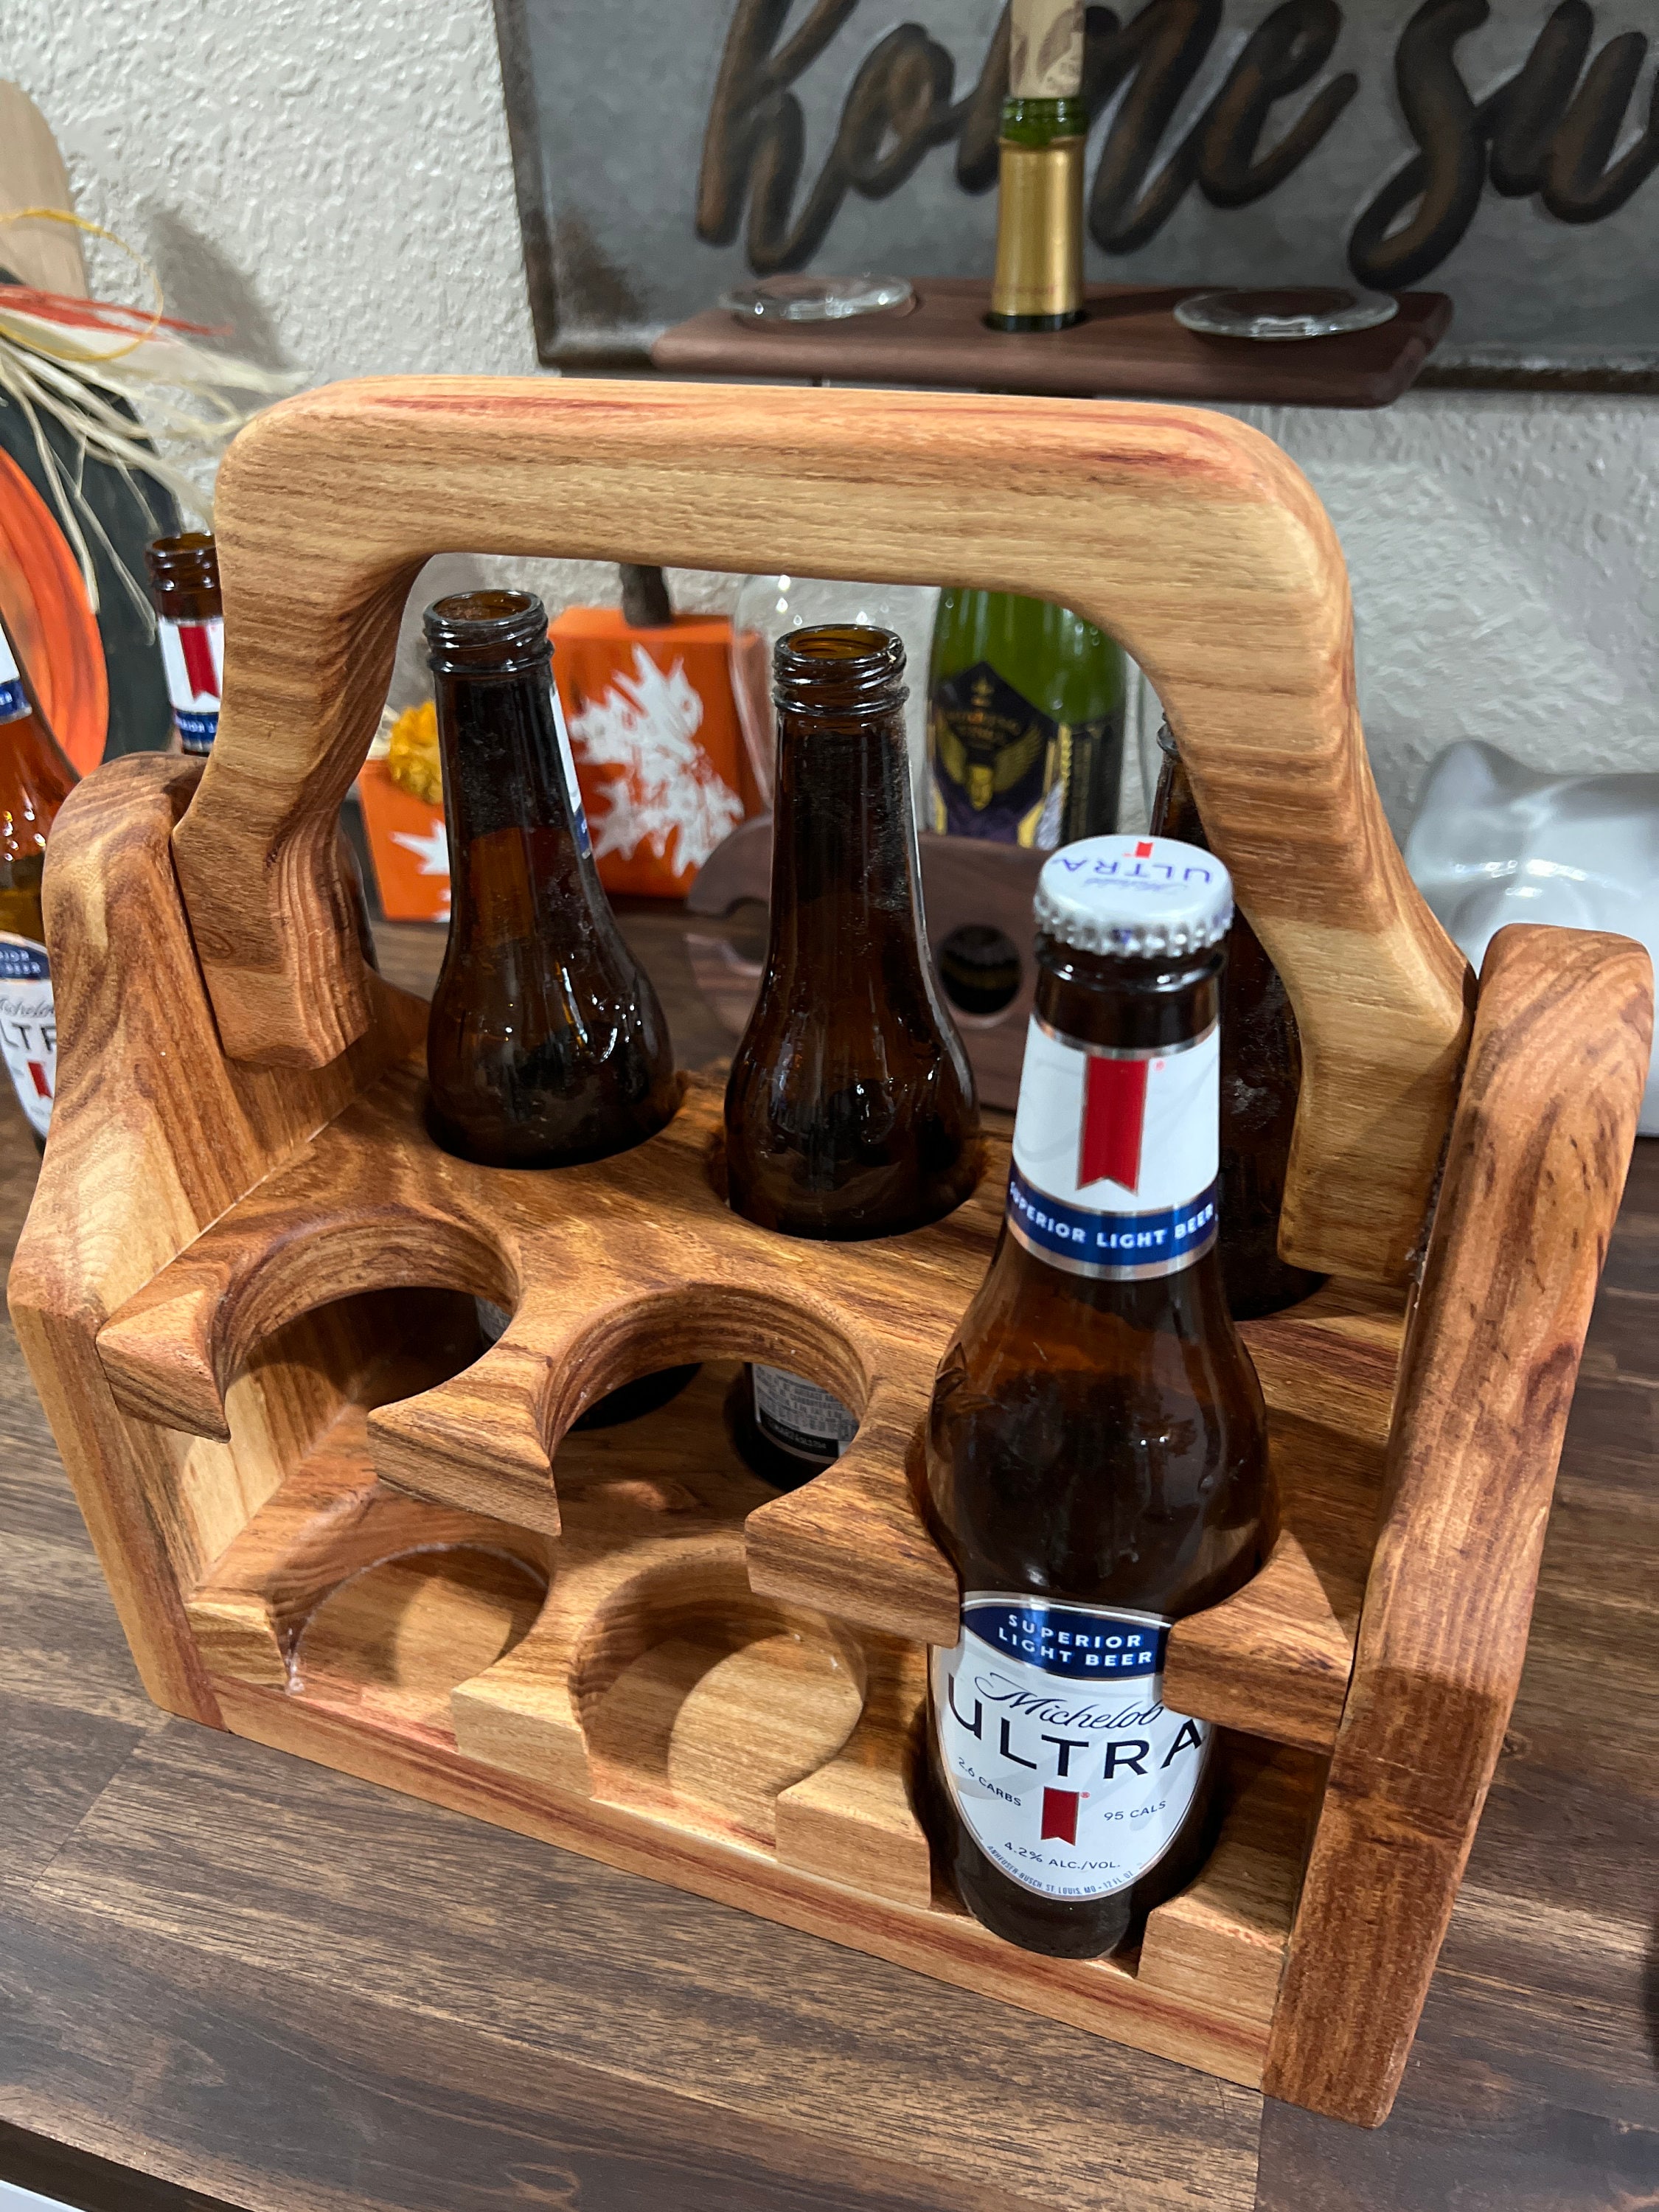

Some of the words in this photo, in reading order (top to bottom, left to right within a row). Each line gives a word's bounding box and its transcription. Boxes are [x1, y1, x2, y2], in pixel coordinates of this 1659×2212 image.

[1050, 858, 1211, 884] ULTRA
[1010, 1181, 1087, 1244] SUPERIOR
[1096, 1228, 1167, 1250] LIGHT
[1174, 1203, 1214, 1240] BEER
[998, 1626, 1073, 1663] LIGHT
[1085, 1650, 1153, 1667] BEER
[1008, 1613, 1142, 1649] SUPERIOR
[974, 1671, 1165, 1730] Michelob
[947, 1672, 1207, 1780] ULTRA
[959, 1756, 975, 1778] 2.6
[978, 1776, 1022, 1807] CARBS
[1103, 1811, 1124, 1821] 95
[1130, 1800, 1166, 1818] CALS
[1004, 1842, 1043, 1863] 4.2%
[1048, 1859, 1121, 1871] ALC./VOL.
